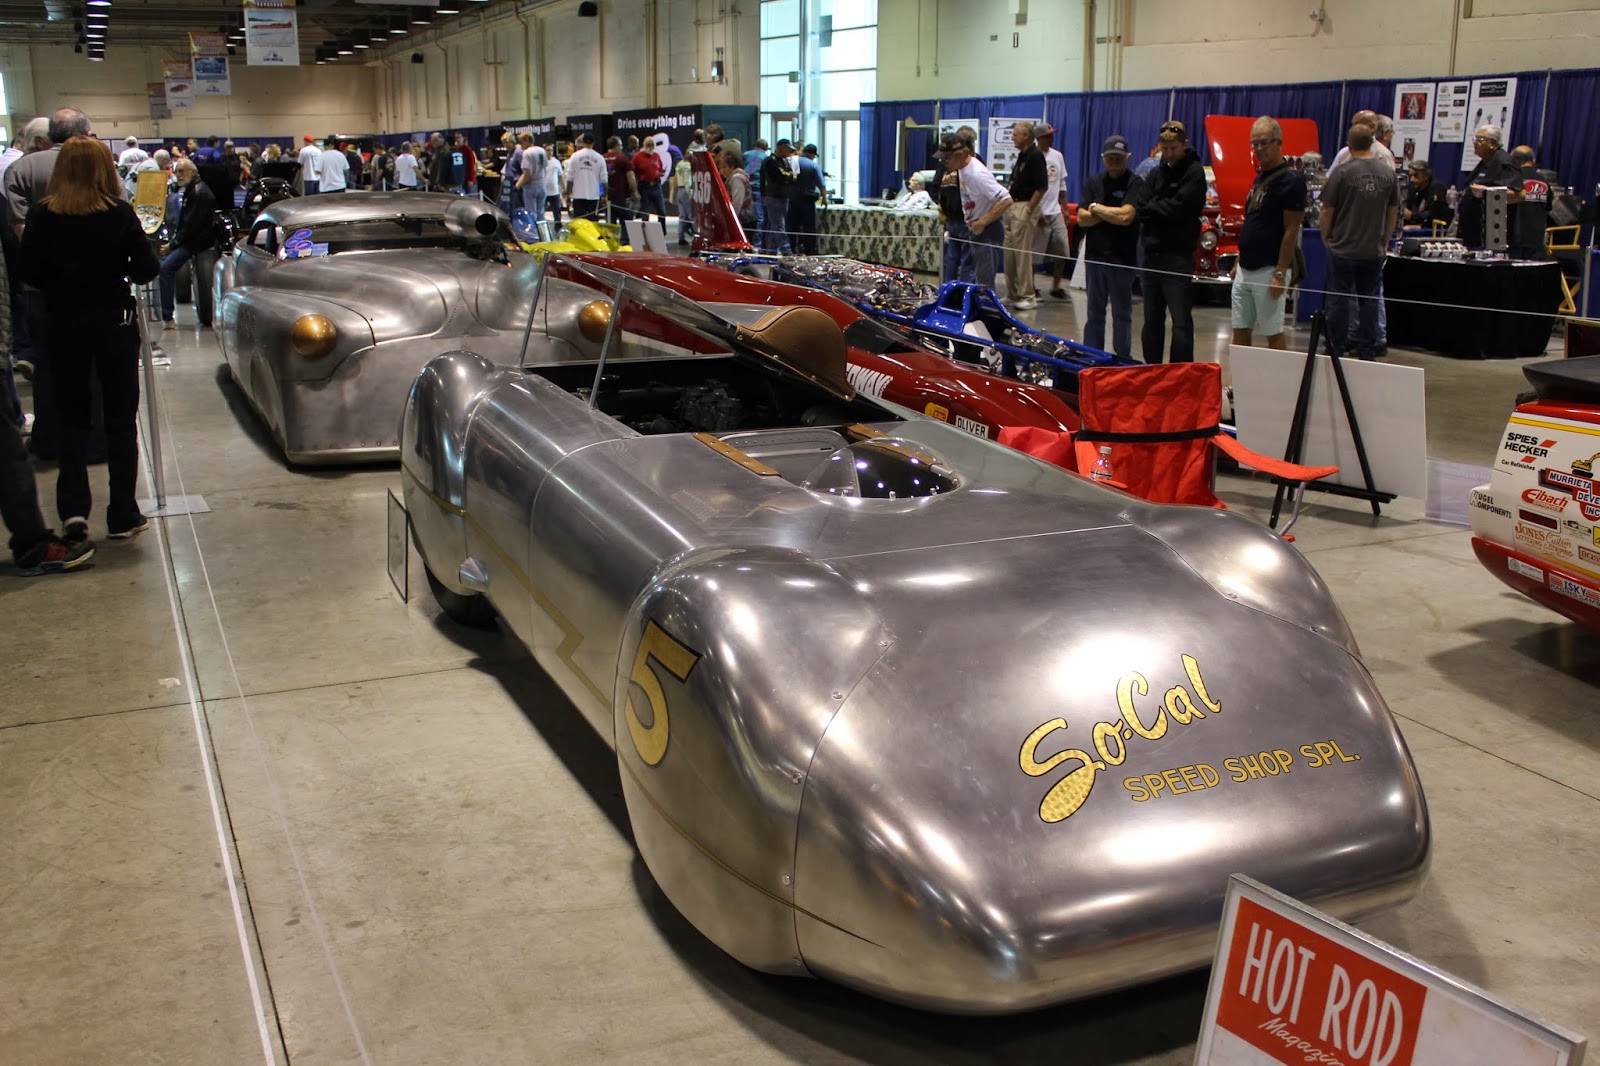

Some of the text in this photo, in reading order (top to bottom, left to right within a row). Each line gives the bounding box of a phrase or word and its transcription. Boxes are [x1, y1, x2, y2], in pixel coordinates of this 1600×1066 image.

[617, 113, 695, 130] Dries everything fast
[957, 417, 986, 438] OLIVER
[1507, 432, 1539, 446] SPIES
[1504, 441, 1548, 458] HECKER
[1510, 461, 1536, 471] Refinishes
[1549, 472, 1592, 489] MURRIETA
[1521, 488, 1568, 508] Eibach
[1514, 521, 1545, 542] JONES
[1564, 581, 1587, 596] ISKY
[624, 617, 703, 769] 5
[1123, 740, 1362, 802] SPEED SHOP SPL.
[1239, 922, 1404, 1066] HOT ROD
